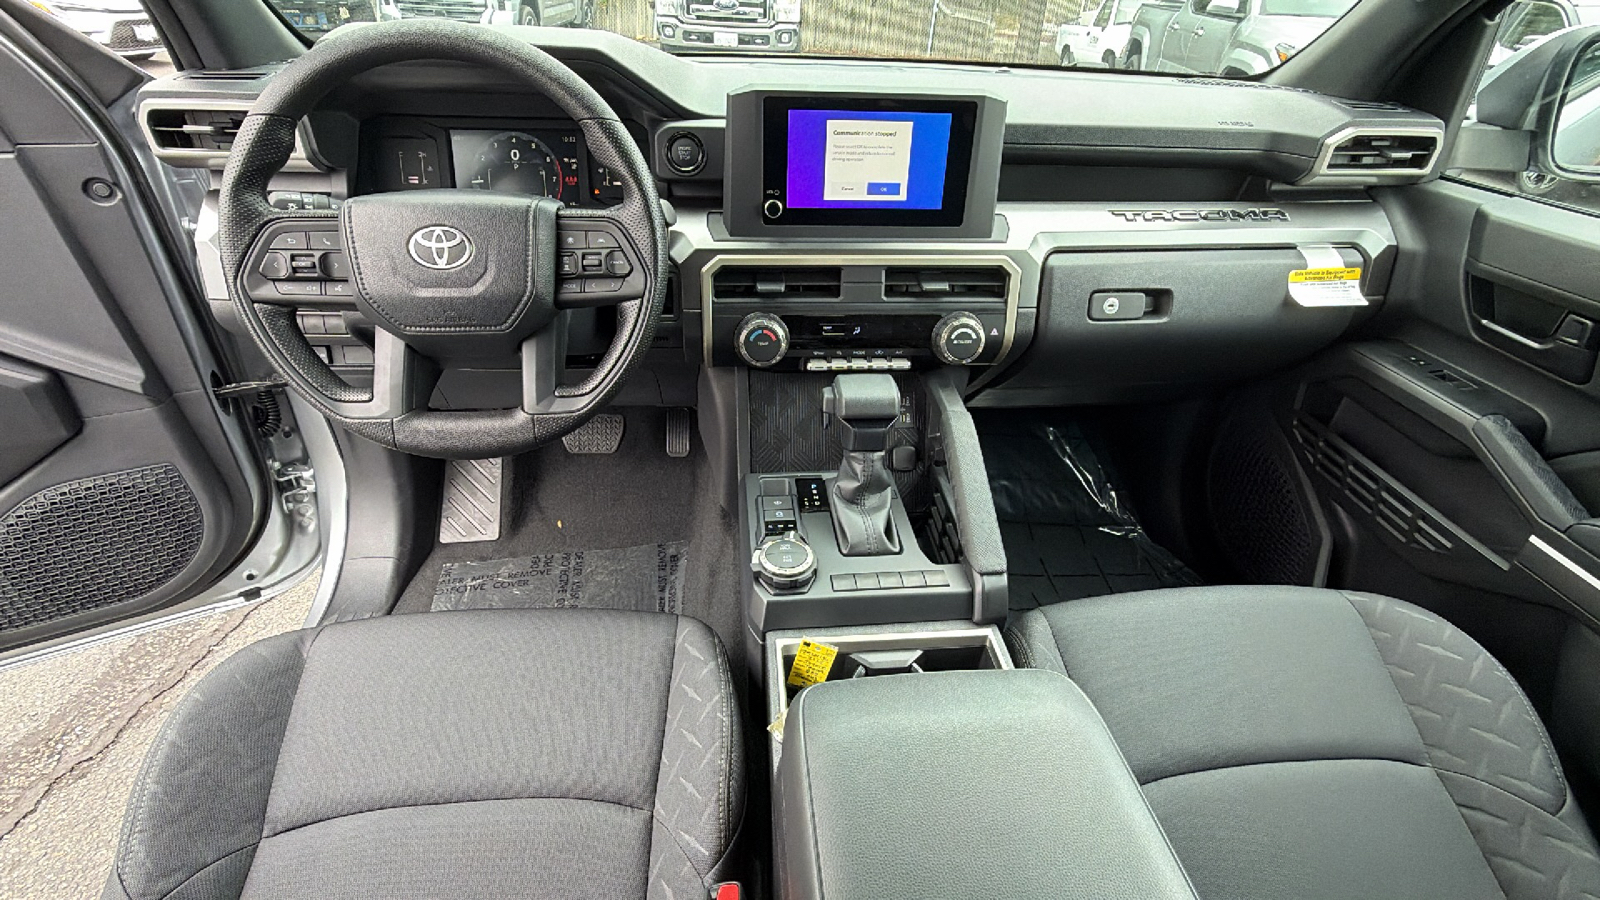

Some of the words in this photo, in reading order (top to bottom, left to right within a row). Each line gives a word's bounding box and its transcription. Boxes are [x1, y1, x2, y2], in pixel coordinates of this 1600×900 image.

[510, 149, 520, 161] 0
[1108, 207, 1291, 222] TACOMA
[573, 551, 584, 577] DEALER
[508, 568, 552, 580] REMOVE
[558, 552, 571, 594] PROTECTIVE
[493, 579, 529, 590] COVER
